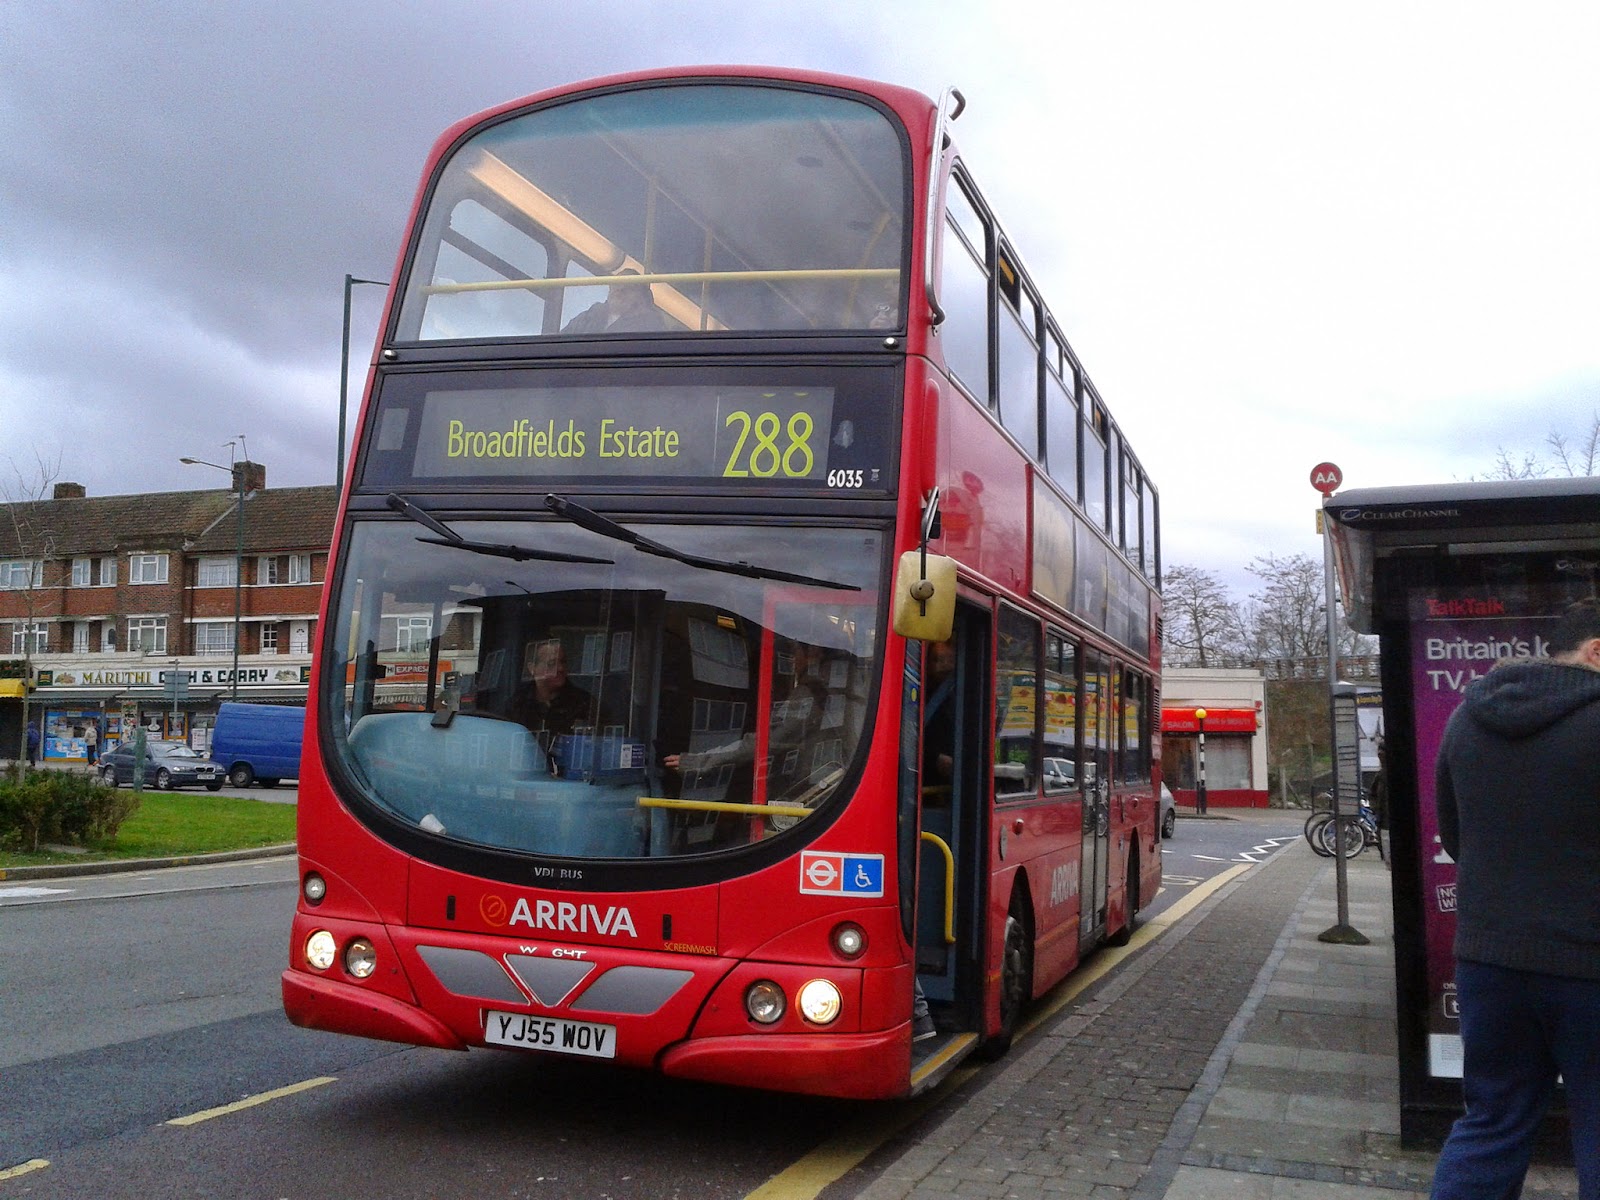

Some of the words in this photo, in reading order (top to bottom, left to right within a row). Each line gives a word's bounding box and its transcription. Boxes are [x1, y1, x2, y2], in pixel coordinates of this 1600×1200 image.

[447, 419, 586, 459] Broadfields
[599, 419, 679, 458] Estate
[722, 411, 814, 478] 288
[827, 469, 864, 488] 6035
[1314, 471, 1338, 483] AA
[1425, 598, 1505, 616] TalkTalk
[1426, 635, 1531, 659] Britain's
[82, 670, 152, 685] MARUTHI
[202, 671, 213, 683] &
[217, 669, 268, 683] CARRY
[560, 869, 583, 880] BUS
[1050, 860, 1079, 908] ARRIVA
[509, 897, 638, 938] ARRIVA
[664, 942, 717, 955] SCREENWASH
[499, 1014, 557, 1046] YJ55
[563, 1023, 607, 1052] WOV
